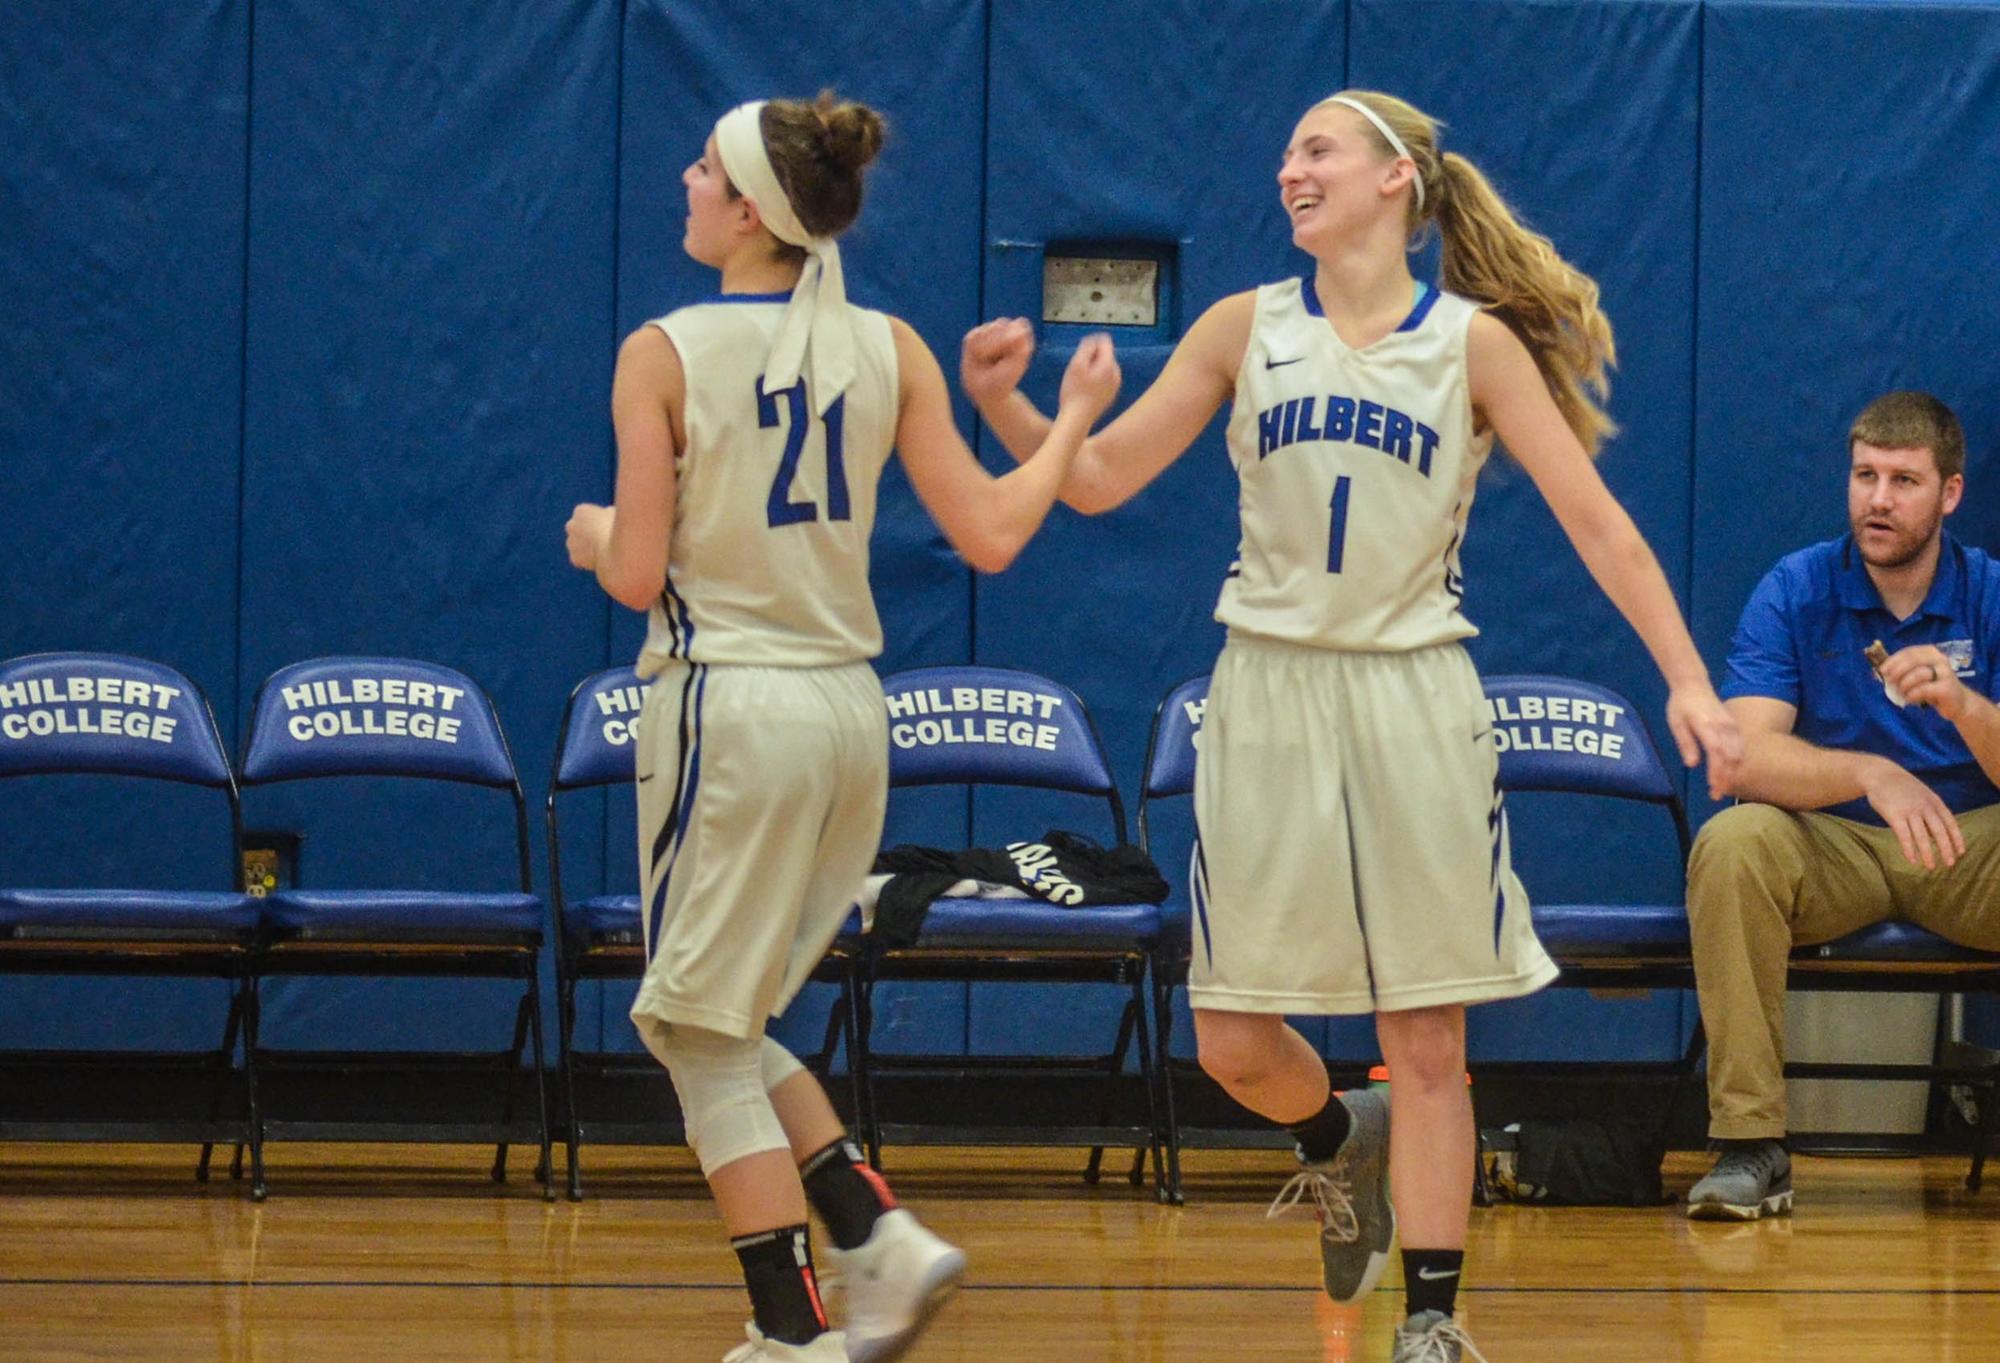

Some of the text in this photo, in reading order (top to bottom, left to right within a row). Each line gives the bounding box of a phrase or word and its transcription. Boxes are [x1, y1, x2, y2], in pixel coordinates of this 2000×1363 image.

[755, 374, 851, 528] 21
[1258, 395, 1440, 479] HILBERT
[1326, 475, 1351, 574] 1
[0, 677, 181, 710] HILBERT
[282, 679, 464, 711] HILBERT
[885, 688, 1062, 719] HILBERT
[2, 708, 177, 744] COLLEGE
[288, 709, 461, 744] COLLEGE
[1486, 696, 1624, 728] ILBERT
[892, 718, 1060, 751] COLLEGE
[1491, 726, 1624, 760] OLLEGE
